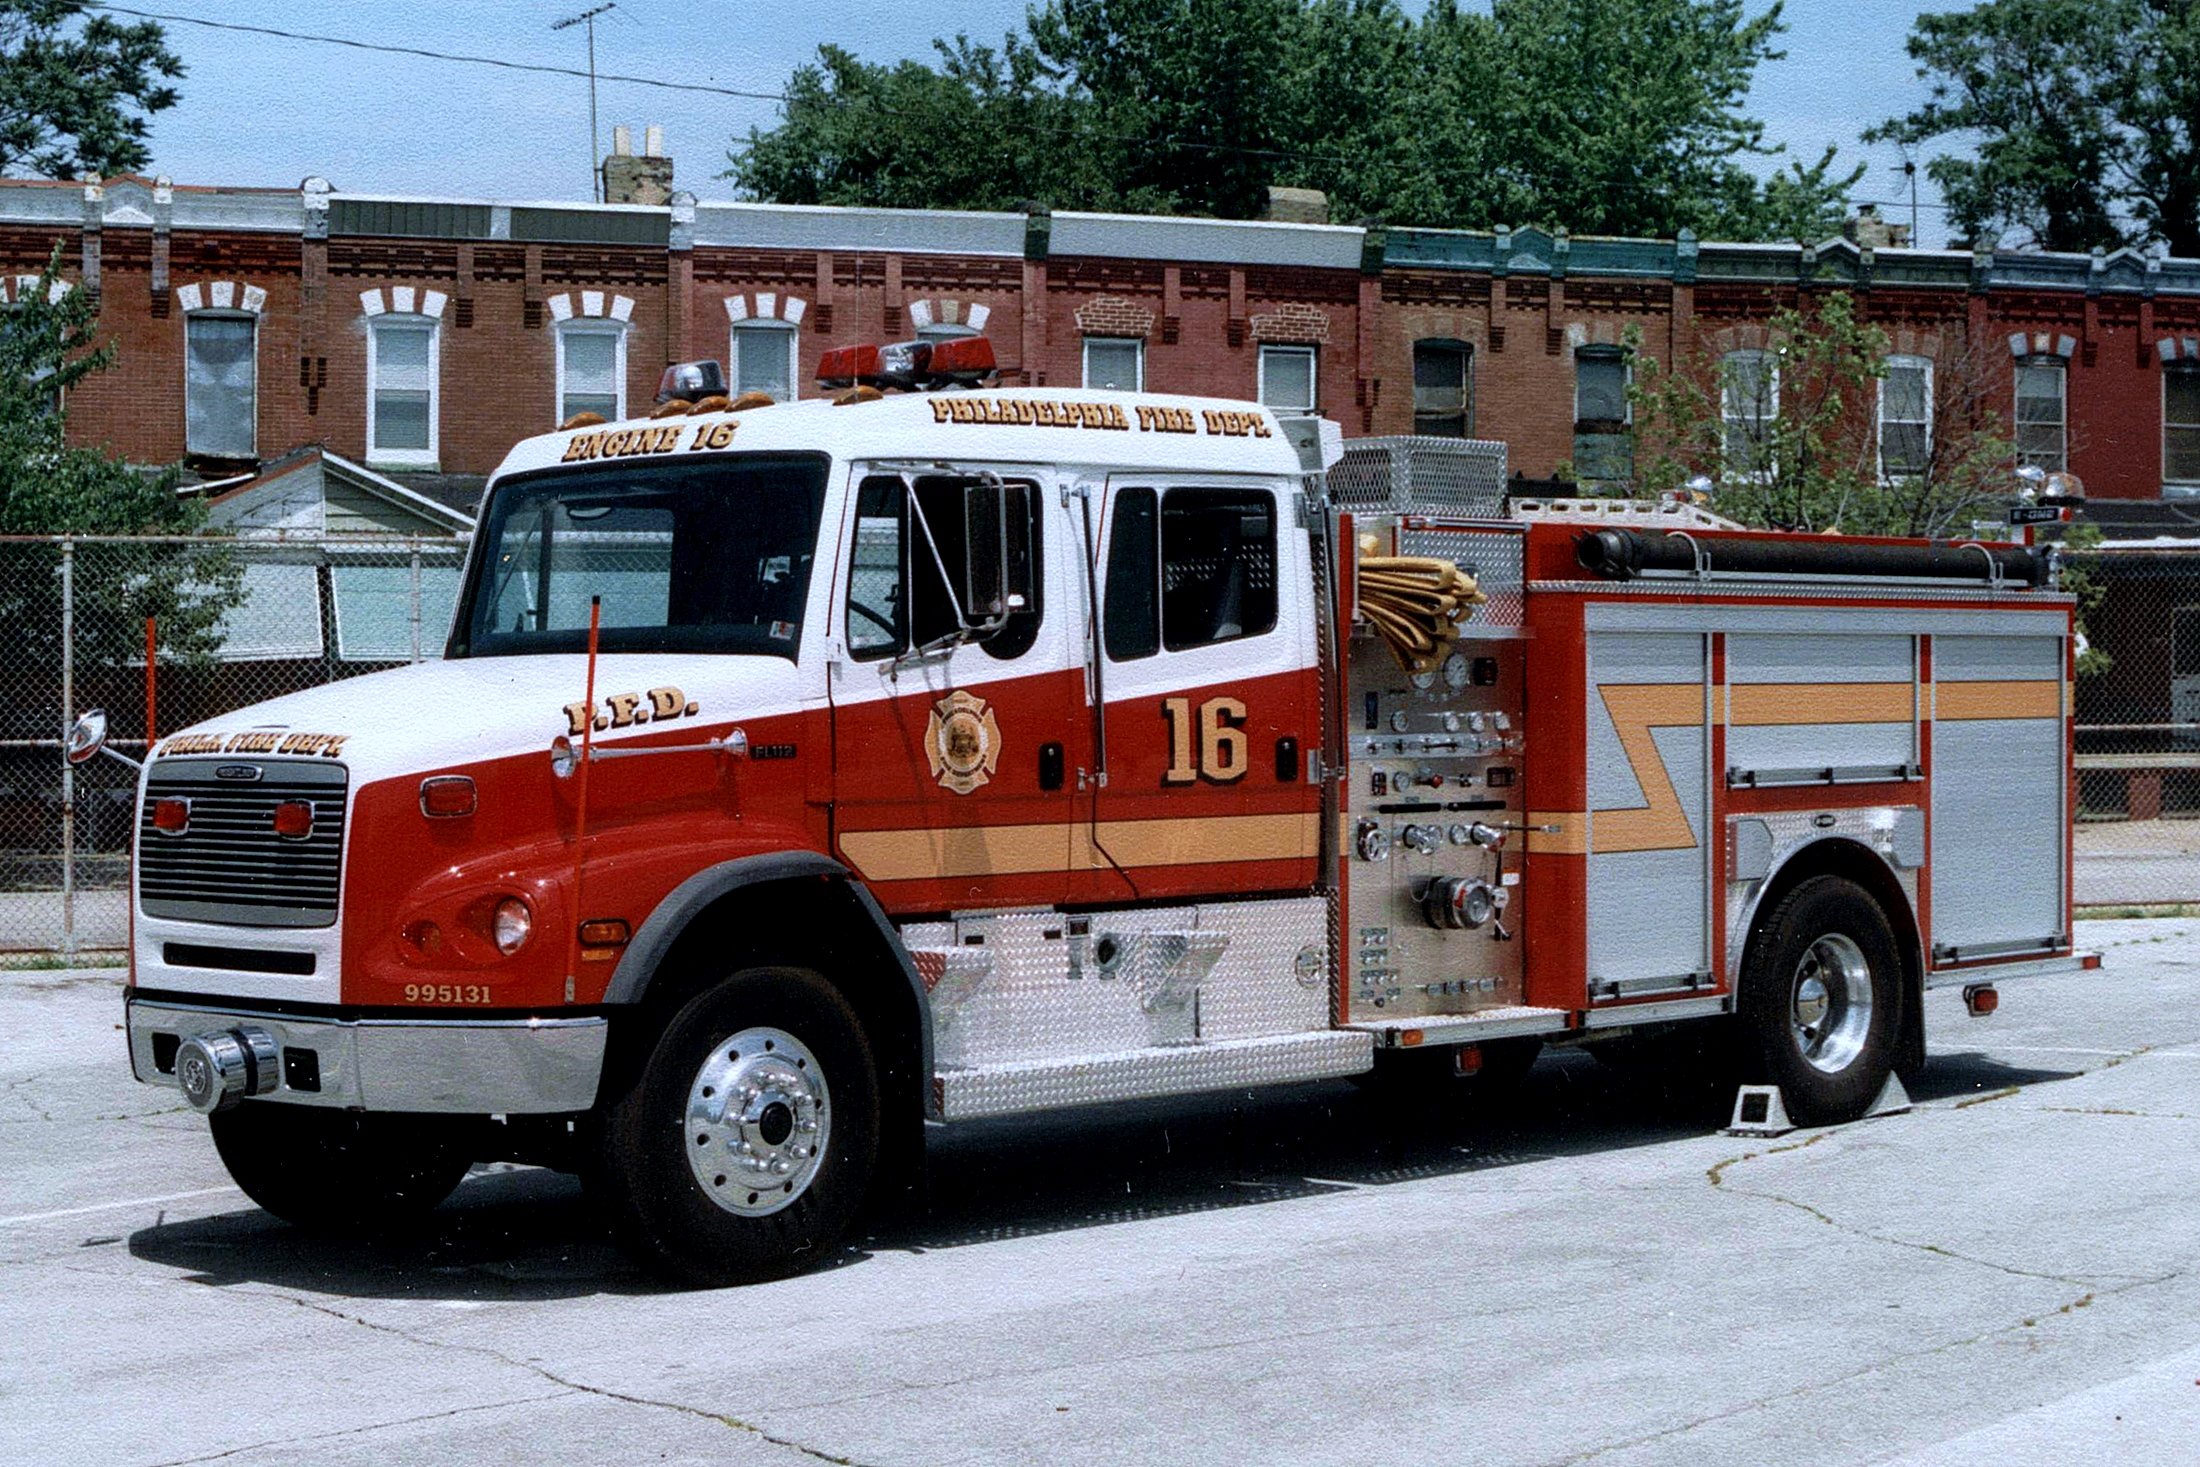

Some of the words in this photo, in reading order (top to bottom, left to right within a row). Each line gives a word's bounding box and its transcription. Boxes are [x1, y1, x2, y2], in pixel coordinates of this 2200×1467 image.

[928, 398, 1129, 430] PHILADELPHIA
[1136, 404, 1197, 434] FIRE
[1202, 409, 1273, 438] DEPT.
[561, 425, 686, 463] ENGINE
[689, 420, 741, 451] 16
[563, 686, 700, 737] P.F.D.
[224, 731, 285, 754] FIRE
[1160, 696, 1248, 787] 16
[404, 983, 492, 1004] 995131
